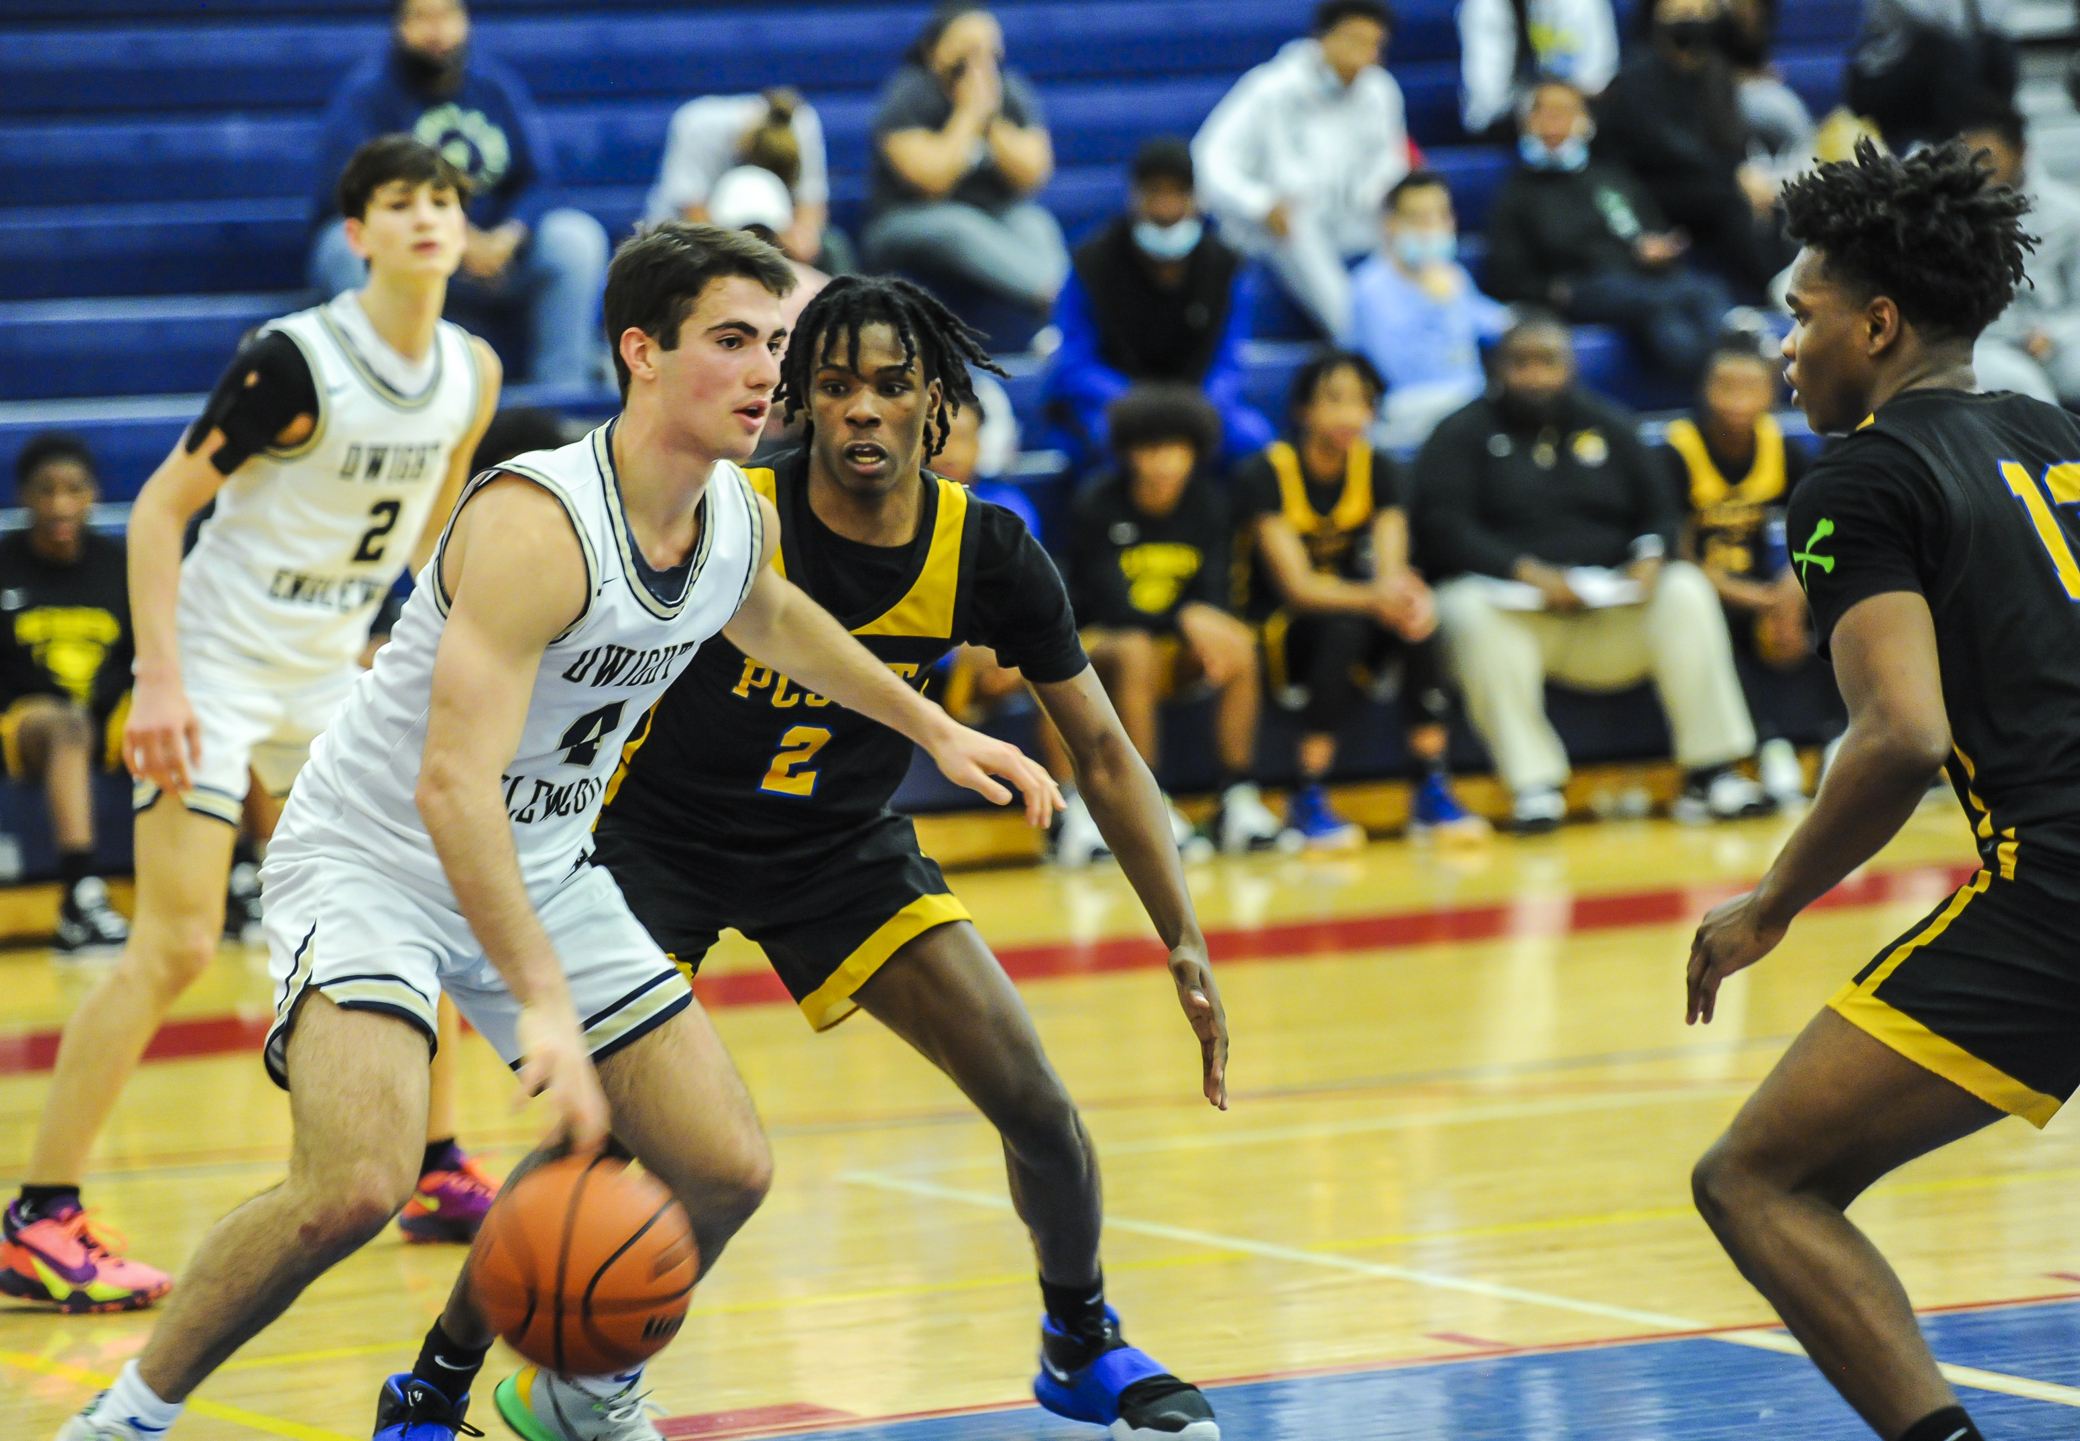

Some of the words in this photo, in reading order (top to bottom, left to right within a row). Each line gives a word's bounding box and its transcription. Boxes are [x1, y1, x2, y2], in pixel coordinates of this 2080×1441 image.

[353, 499, 401, 561] 2
[561, 640, 696, 688] DWIGHT
[555, 698, 630, 770] 4
[756, 721, 835, 799] 2
